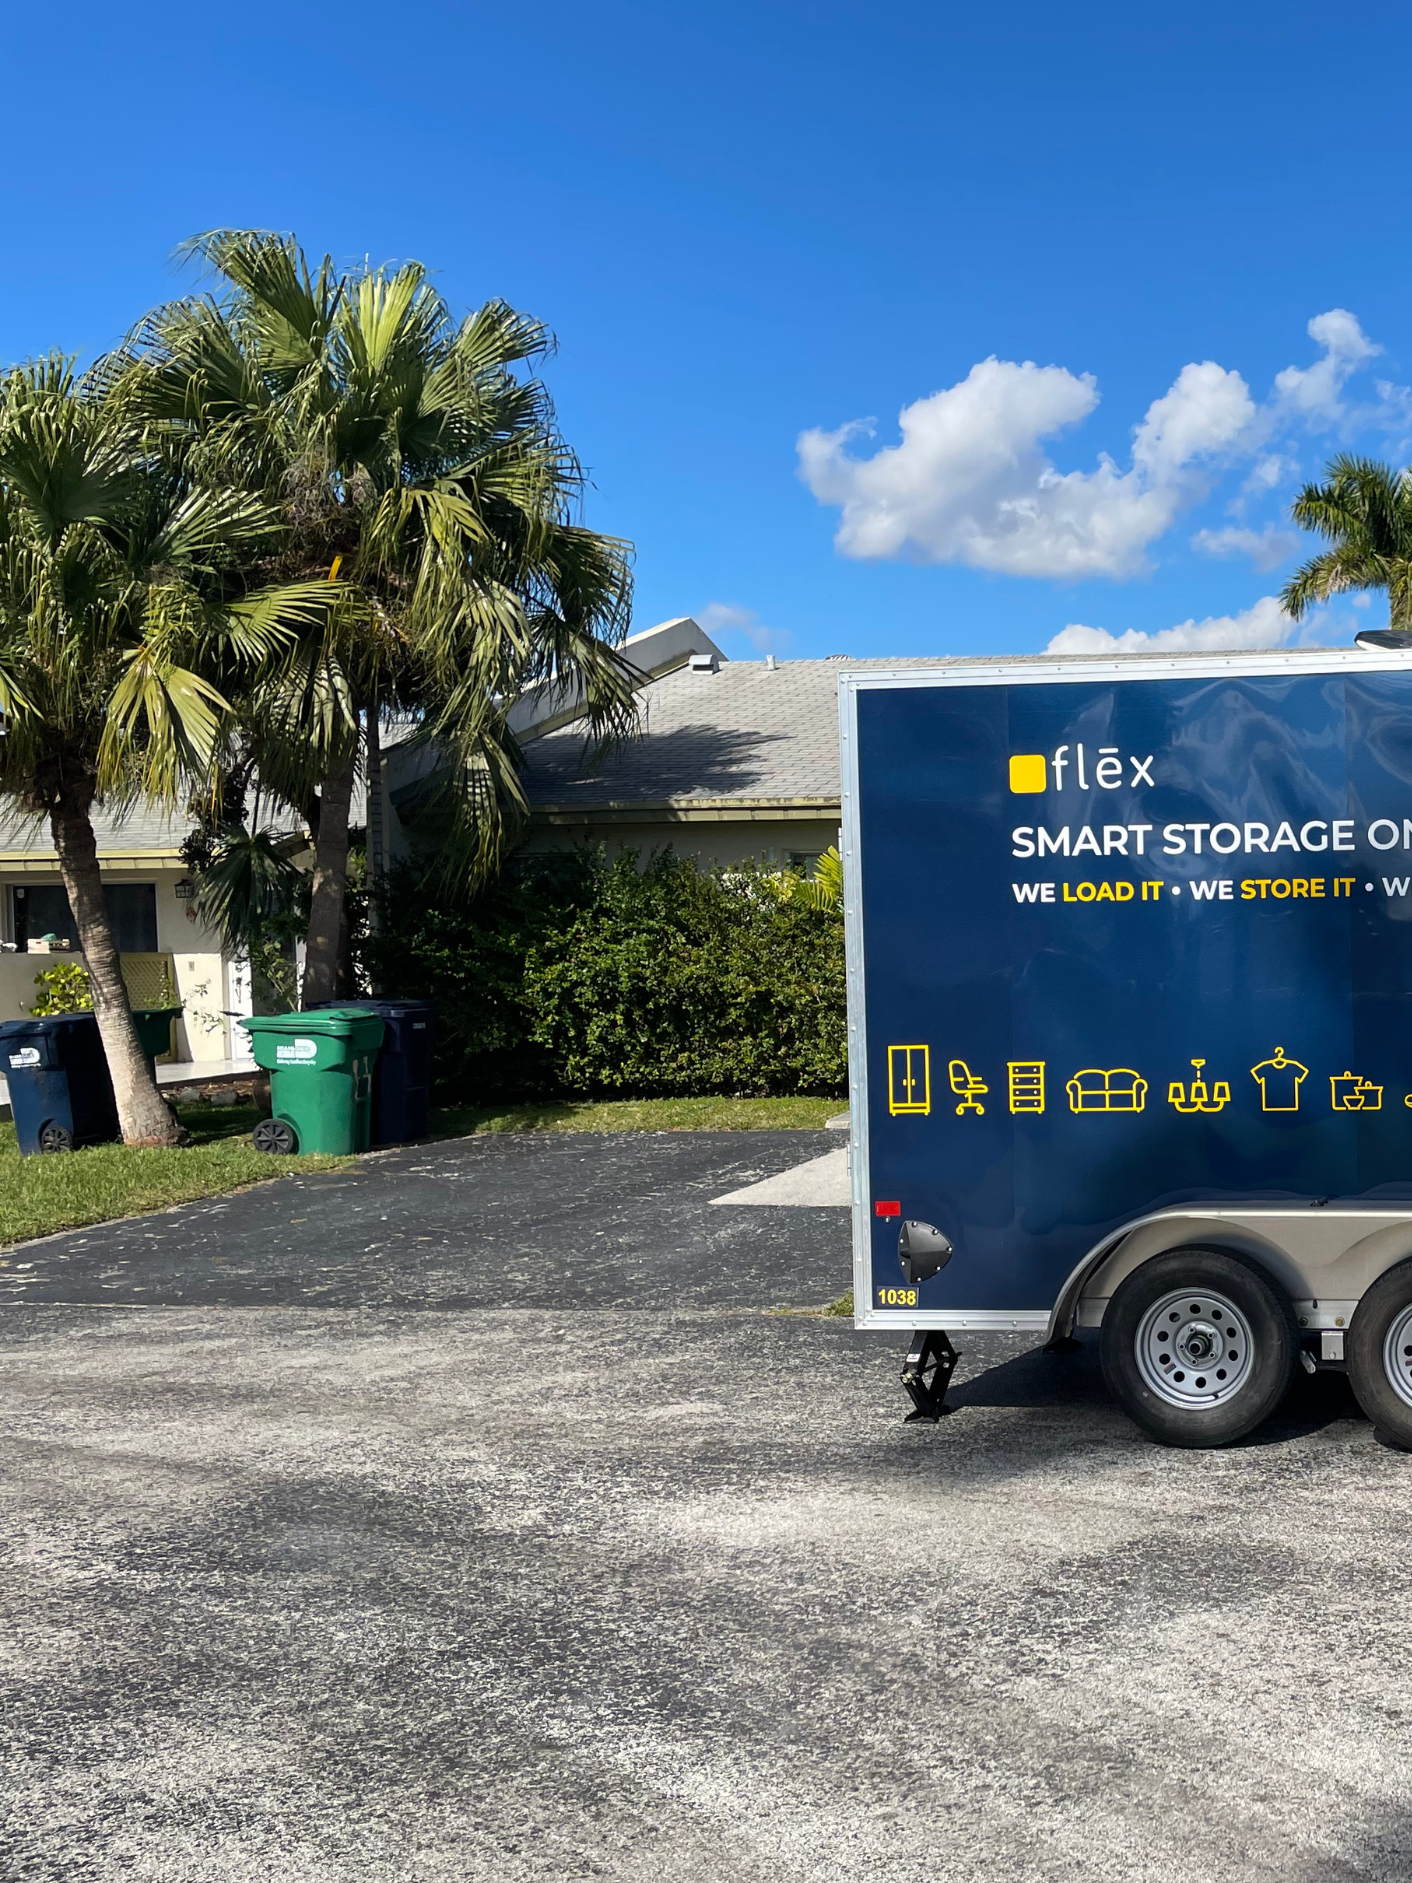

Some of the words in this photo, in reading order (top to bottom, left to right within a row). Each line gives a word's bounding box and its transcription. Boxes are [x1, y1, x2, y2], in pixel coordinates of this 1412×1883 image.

[1012, 824, 1153, 858] SMART
[1162, 820, 1356, 855] STORAGE
[1012, 882, 1056, 903] WE
[1062, 881, 1135, 902] LOAD
[1141, 880, 1165, 901] IT
[1189, 879, 1234, 901] WE
[1240, 877, 1326, 900] STORE
[1333, 876, 1356, 898] IT
[878, 1288, 917, 1306] 1038
